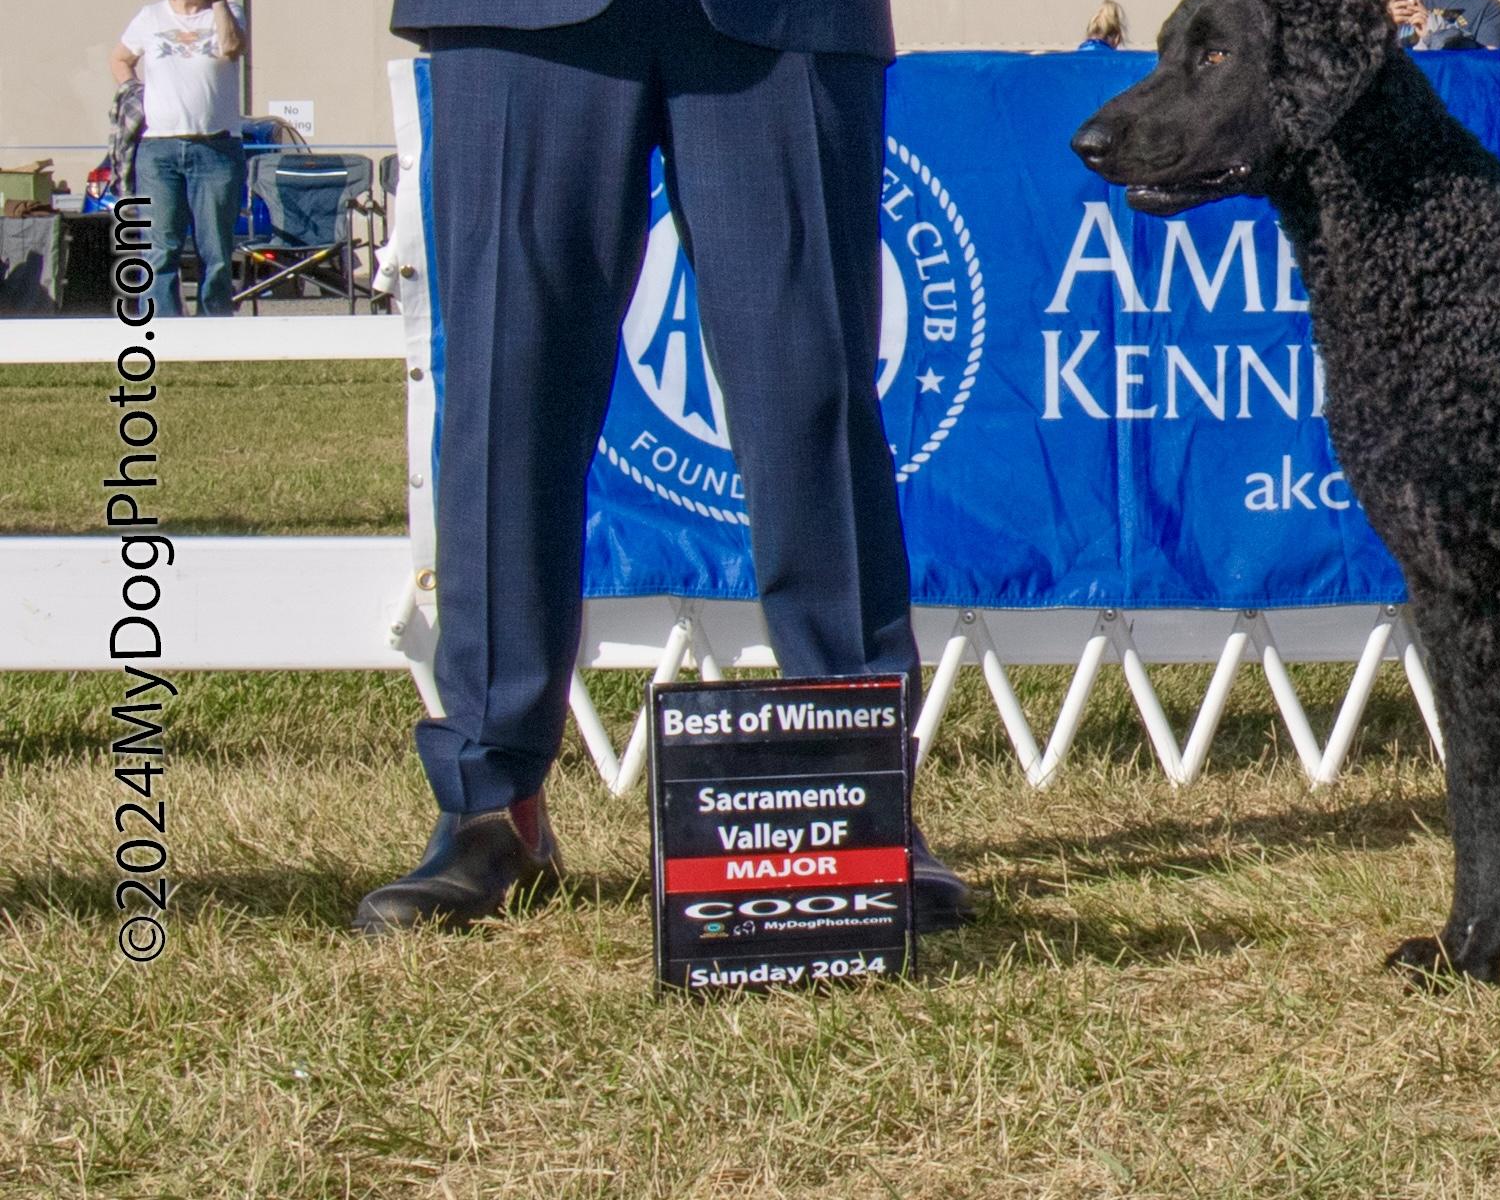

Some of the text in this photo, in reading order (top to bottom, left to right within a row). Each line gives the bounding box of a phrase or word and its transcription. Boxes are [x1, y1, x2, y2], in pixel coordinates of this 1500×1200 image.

[284, 105, 299, 115] No
[1043, 201, 1311, 313] AME
[906, 221, 958, 343] CLUB
[1041, 330, 1327, 421] KENN
[1244, 454, 1363, 512] akc
[663, 703, 896, 736] Best of Winners
[699, 784, 866, 812] Sacramento
[718, 821, 848, 853] Valley DF
[726, 857, 838, 880] MAJOR
[684, 892, 898, 919] COOK
[764, 916, 893, 930] MyDogPhoto.com
[690, 957, 886, 987] Sunday 2024
